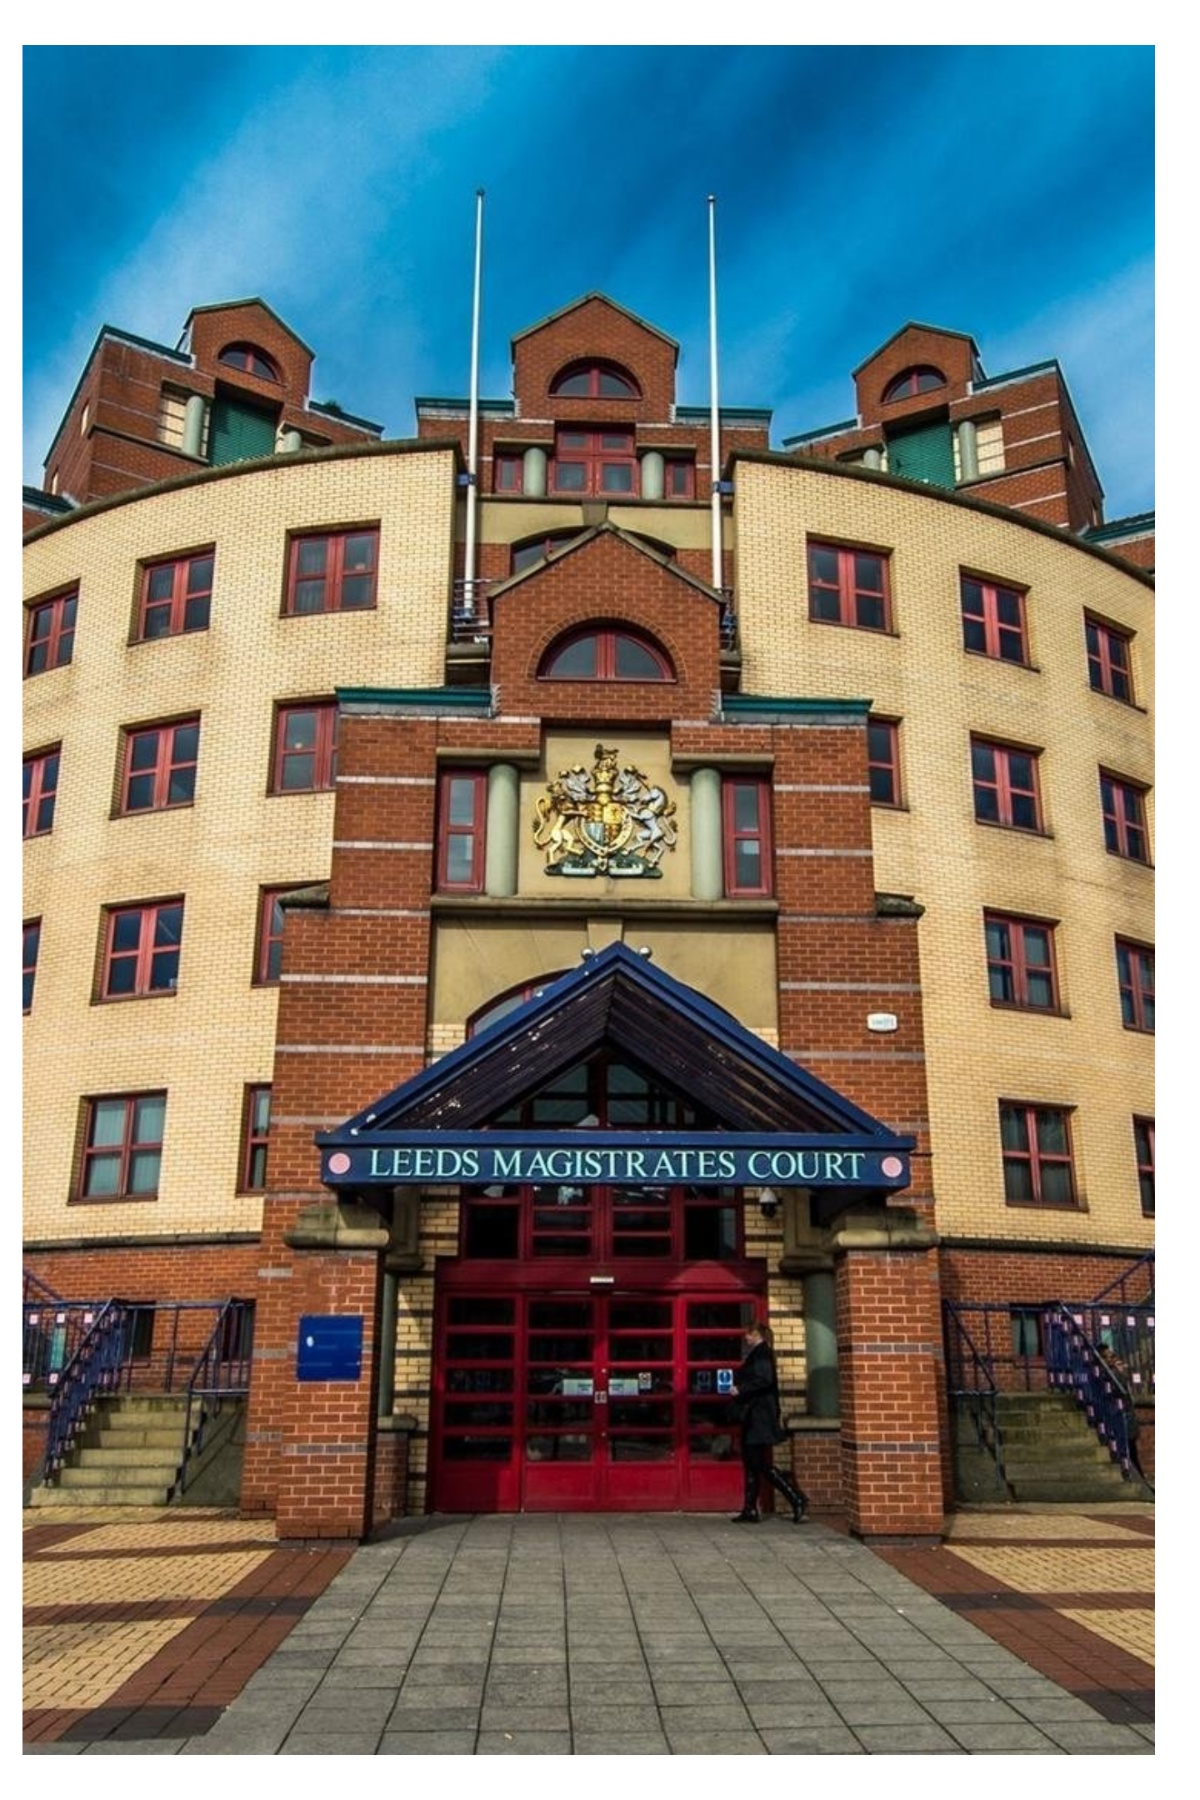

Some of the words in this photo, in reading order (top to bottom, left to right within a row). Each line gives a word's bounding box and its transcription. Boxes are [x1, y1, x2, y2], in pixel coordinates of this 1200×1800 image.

[369, 1148, 480, 1177] LEEDS
[493, 1149, 736, 1179] MAGISTRATES
[747, 1151, 865, 1180] COURT
